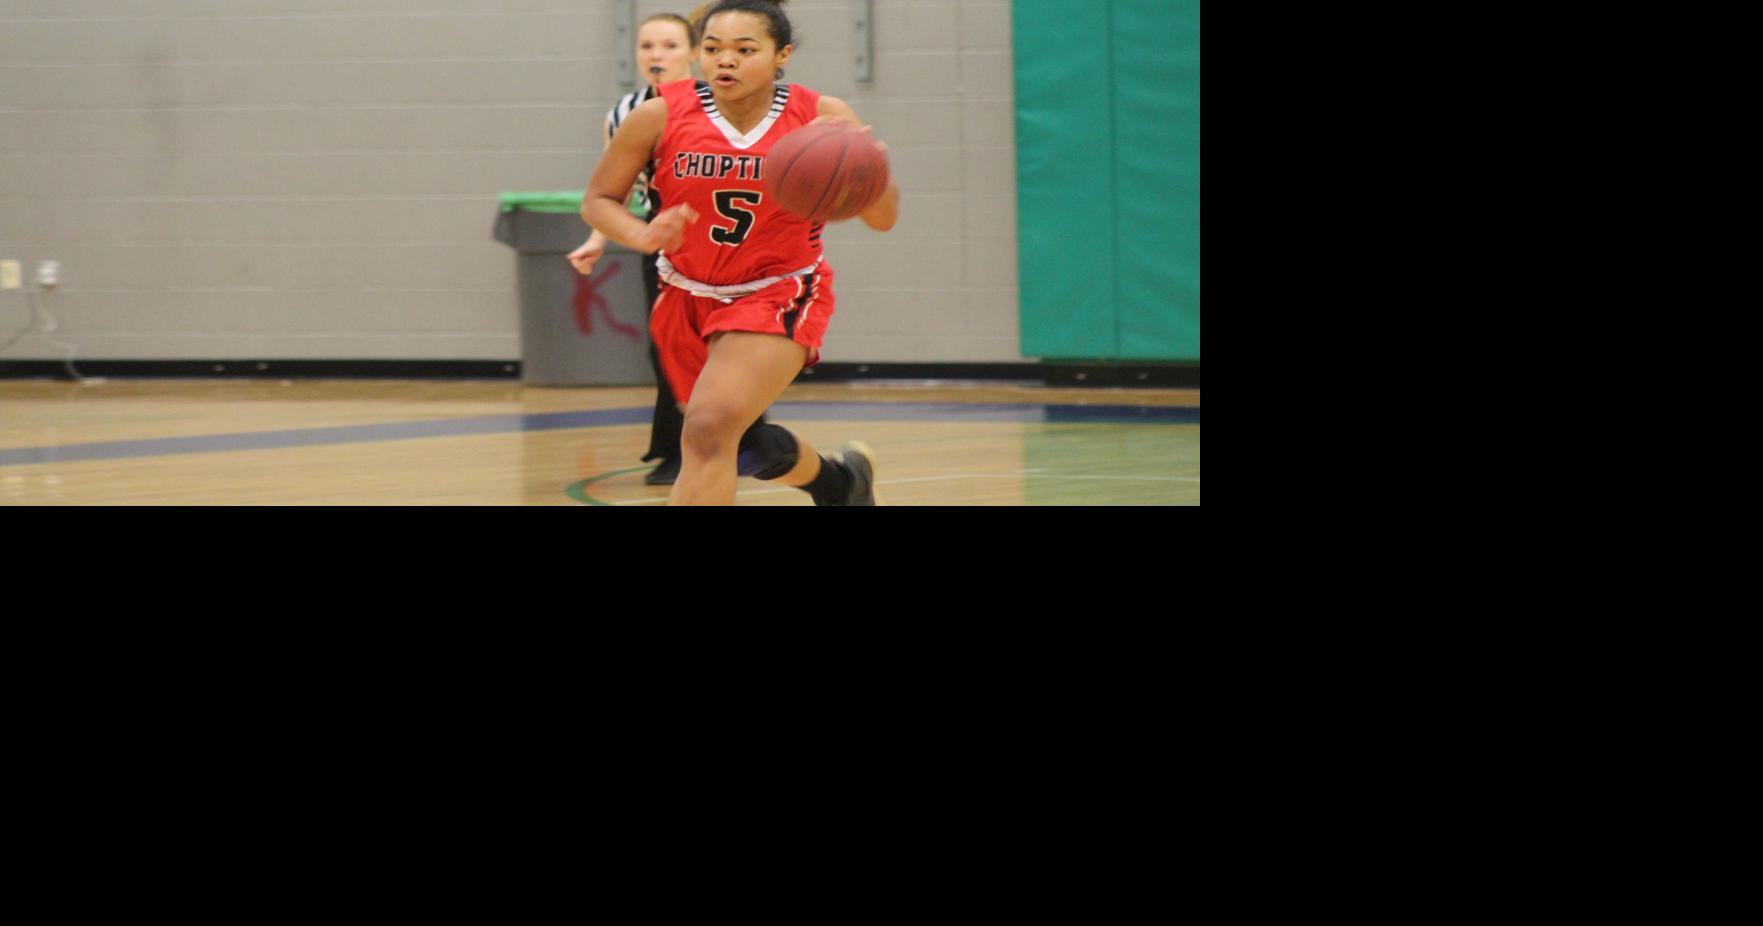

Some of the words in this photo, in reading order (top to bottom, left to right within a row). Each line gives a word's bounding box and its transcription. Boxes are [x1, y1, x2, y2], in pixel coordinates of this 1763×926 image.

[674, 152, 766, 180] CHOPTI
[709, 189, 763, 246] 5
[571, 260, 642, 341] K
